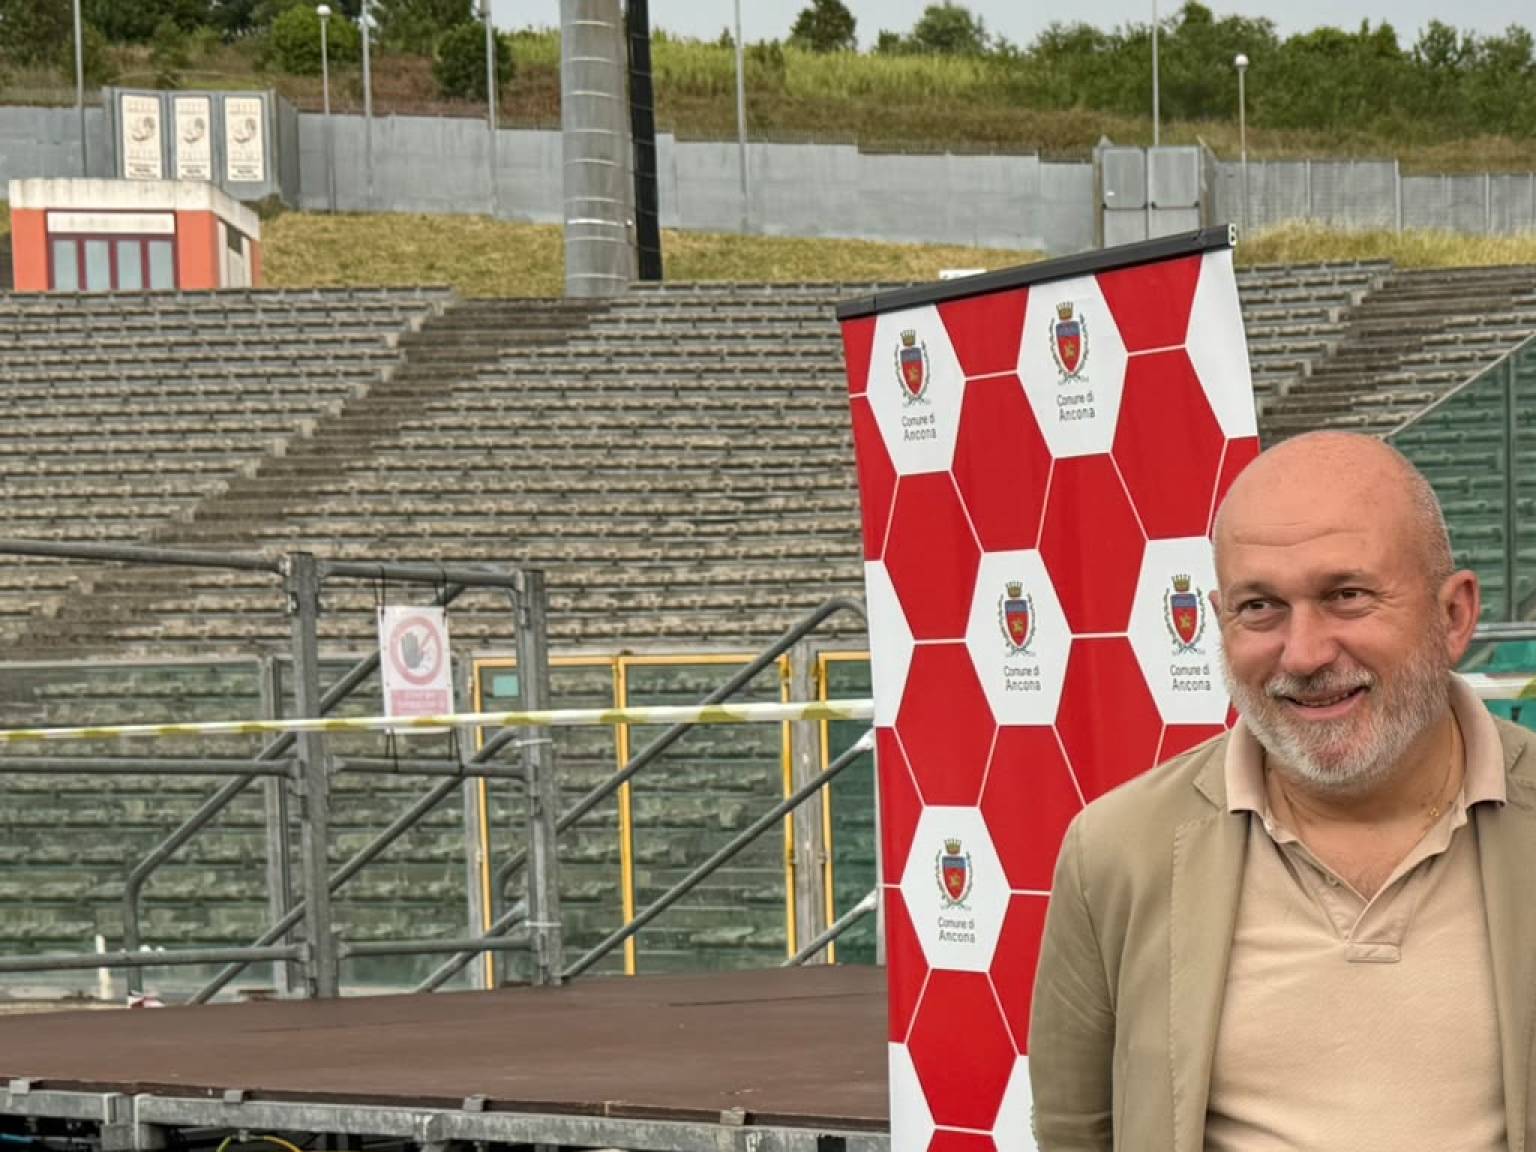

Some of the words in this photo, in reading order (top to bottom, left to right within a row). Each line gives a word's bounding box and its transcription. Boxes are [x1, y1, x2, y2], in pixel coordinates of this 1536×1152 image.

[1056, 393, 1085, 407] Comune
[1086, 389, 1094, 403] di
[902, 415, 928, 428] Comune
[928, 413, 936, 424] di
[1059, 407, 1095, 422] Ancona
[904, 427, 937, 441] Ancona
[1003, 665, 1031, 678] Comune
[1032, 665, 1040, 676] di
[1169, 664, 1202, 676] Comune
[1203, 664, 1210, 676] di
[1005, 679, 1042, 692] Ancona
[1172, 678, 1212, 692] Ancona
[937, 916, 967, 929] Comune
[968, 918, 976, 930] di
[938, 929, 976, 944] Ancona
